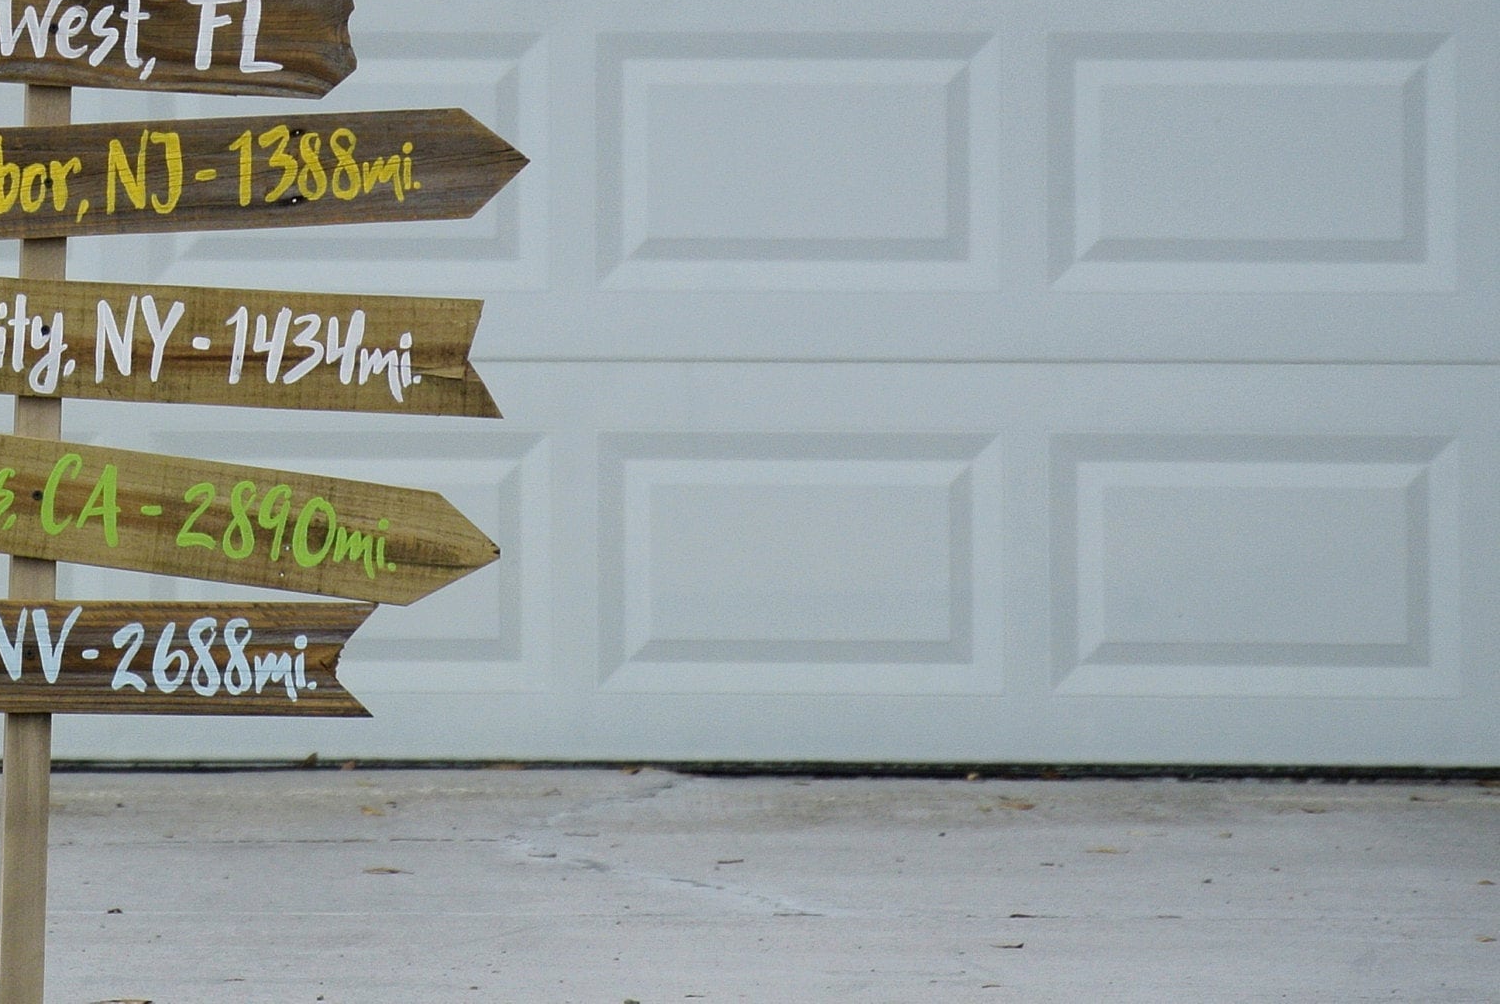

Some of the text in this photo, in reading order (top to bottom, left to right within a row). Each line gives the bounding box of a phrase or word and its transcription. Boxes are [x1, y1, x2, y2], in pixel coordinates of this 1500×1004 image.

[105, 128, 183, 214] NJ
[96, 295, 184, 382] NY
[40, 453, 120, 548] CA
